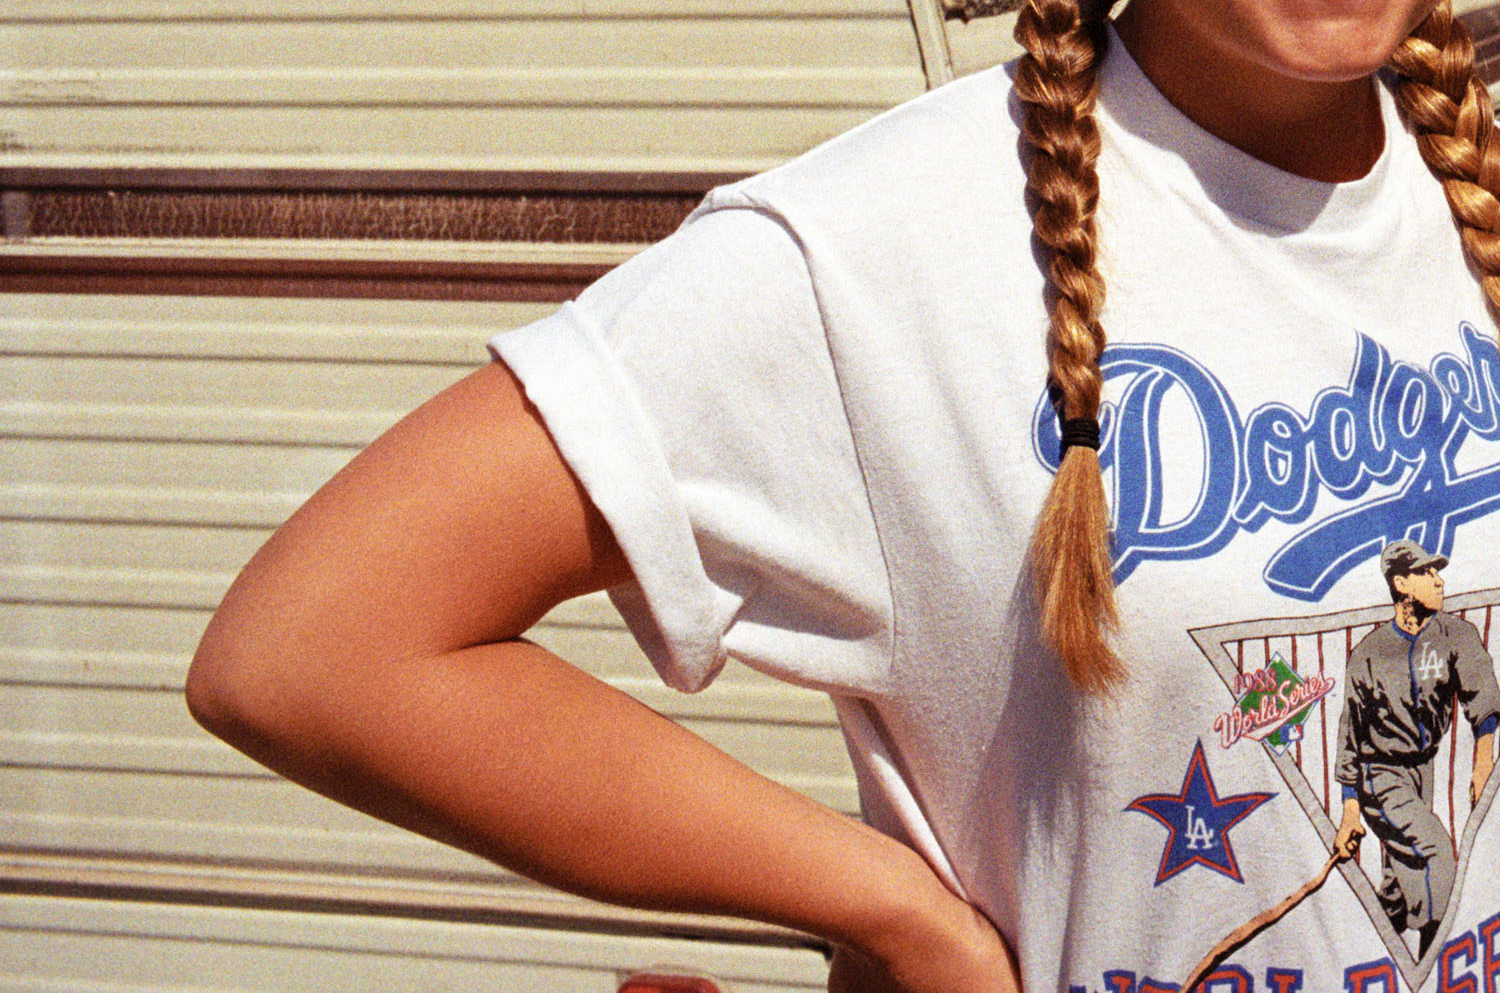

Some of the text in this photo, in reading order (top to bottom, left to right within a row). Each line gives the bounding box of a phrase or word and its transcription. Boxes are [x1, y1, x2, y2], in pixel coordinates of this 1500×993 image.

[1234, 667, 1277, 695] 1988
[1418, 641, 1443, 680] LA
[1213, 671, 1336, 749] World Series
[1184, 804, 1214, 849] LA
